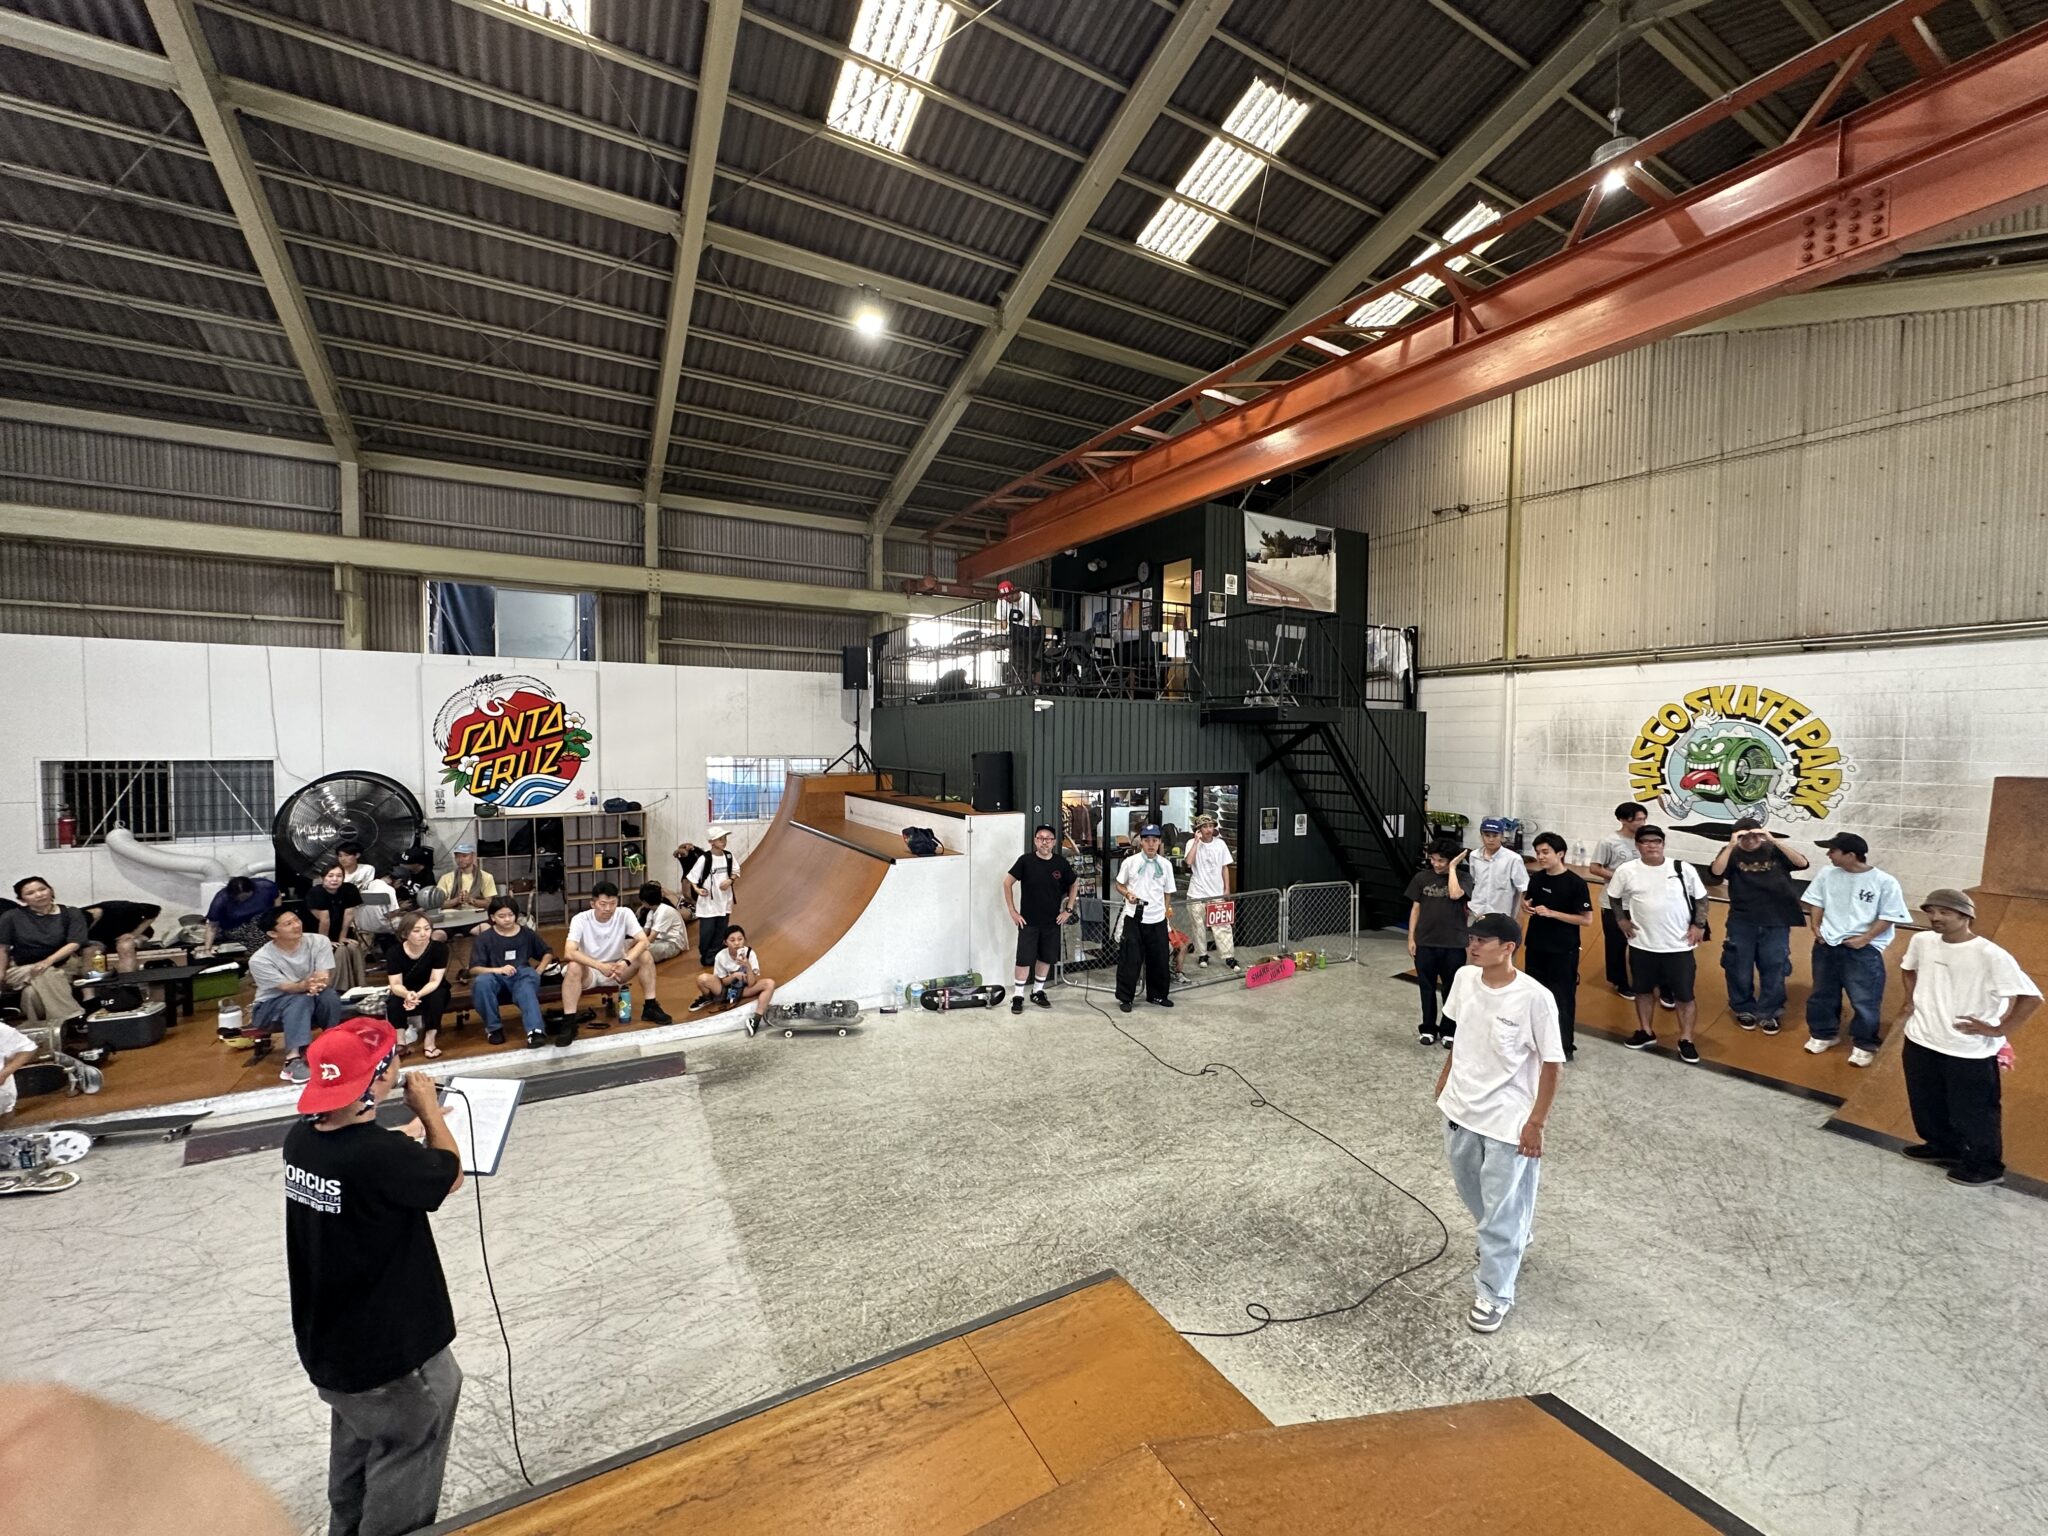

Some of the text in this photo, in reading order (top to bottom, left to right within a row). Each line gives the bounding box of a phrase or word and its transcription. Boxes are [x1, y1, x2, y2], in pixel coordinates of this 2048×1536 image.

[443, 702, 565, 763] SANTA
[1629, 685, 1843, 820] HASCO SKATE PARK
[469, 740, 565, 796] CRUZ
[1208, 909, 1232, 925] OPEN
[284, 1160, 342, 1196] ORCUS
